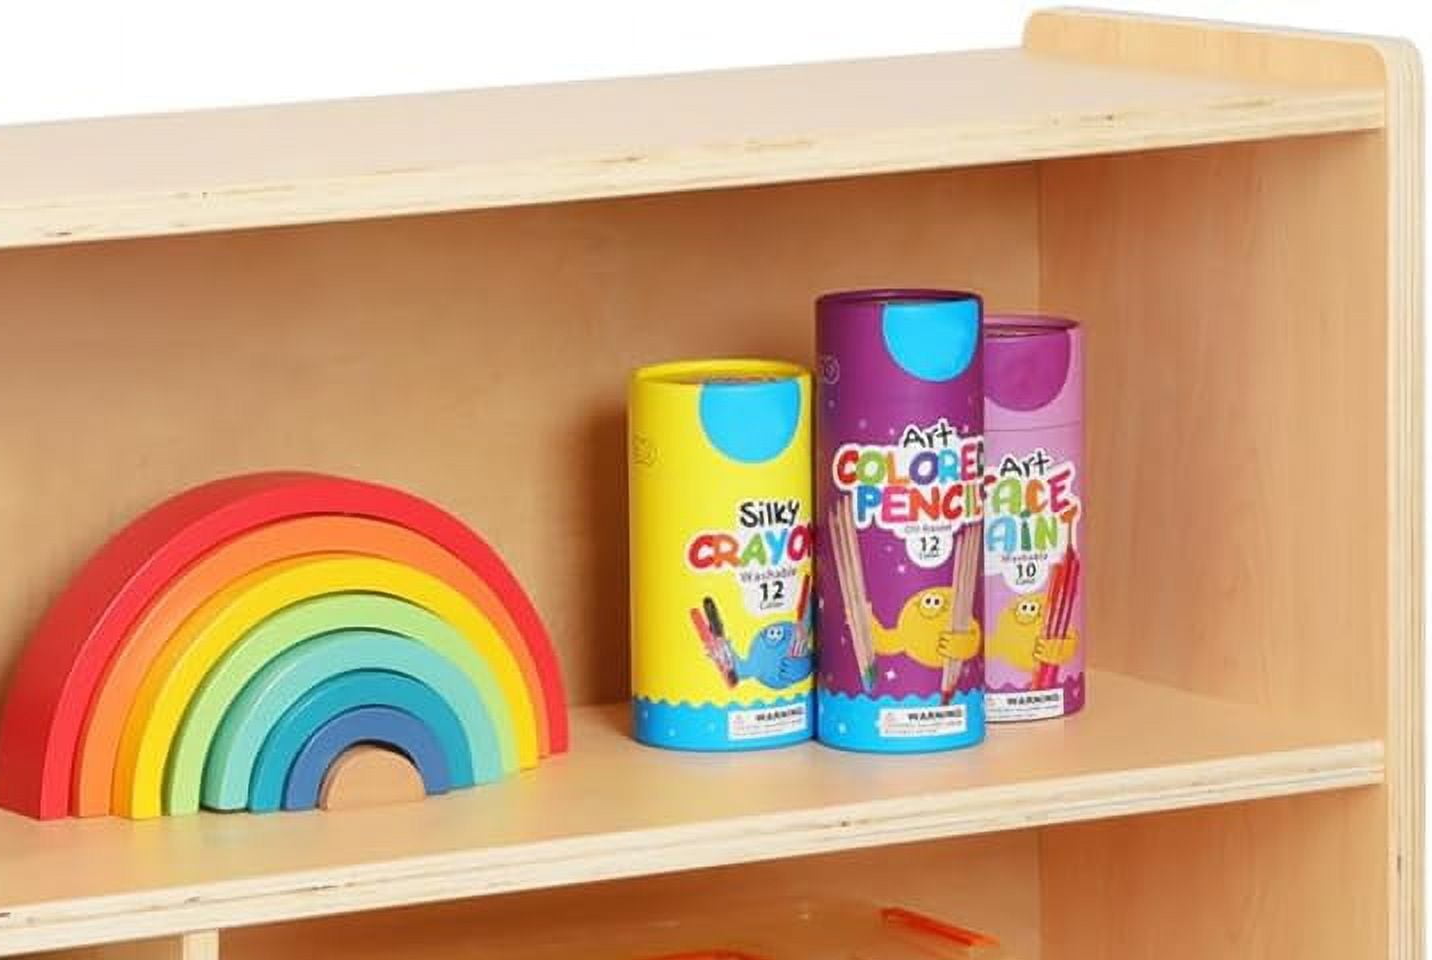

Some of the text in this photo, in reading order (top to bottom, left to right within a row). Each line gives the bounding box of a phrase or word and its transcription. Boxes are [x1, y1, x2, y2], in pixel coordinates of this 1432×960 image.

[903, 422, 952, 448] Art
[1000, 450, 1050, 478] Art
[856, 483, 984, 523] PENCIL
[920, 535, 940, 552] 12
[1015, 562, 1037, 579] 10
[759, 580, 785, 601] 12
